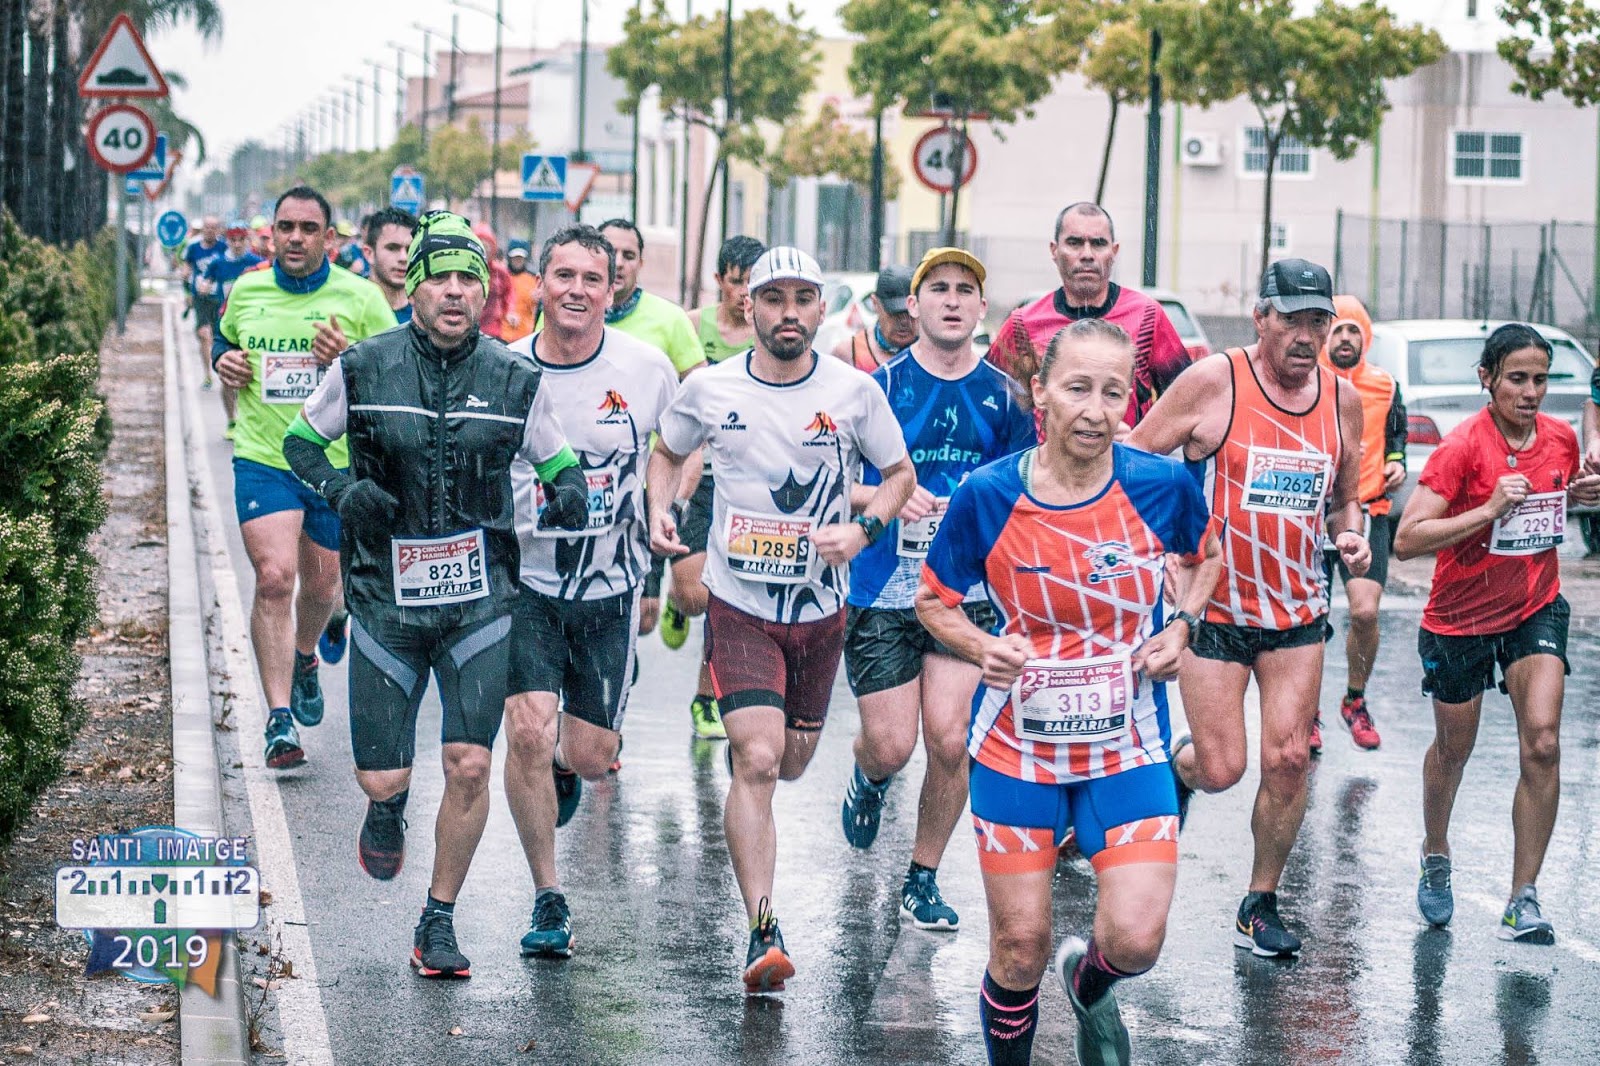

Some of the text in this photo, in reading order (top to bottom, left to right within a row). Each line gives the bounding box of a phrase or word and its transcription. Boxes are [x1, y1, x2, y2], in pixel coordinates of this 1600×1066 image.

[103, 127, 142, 150] 40
[247, 335, 315, 352] BALEAR
[286, 373, 311, 385] 673
[911, 444, 982, 465] ondara
[1254, 457, 1276, 471] 23
[1274, 475, 1312, 493] 1262
[1314, 478, 1322, 492] E
[732, 518, 753, 535] 23
[1523, 518, 1549, 533] 229
[401, 547, 421, 564] 23
[752, 539, 795, 559] 1285
[799, 541, 808, 556] S
[429, 562, 463, 580] 823
[470, 555, 480, 571] C
[1021, 669, 1051, 690] 23
[1050, 665, 1113, 678] CIRCUIT A PEU
[1050, 674, 1110, 686] MARINA ALTA
[1058, 692, 1101, 714] 313
[1113, 686, 1123, 705] E
